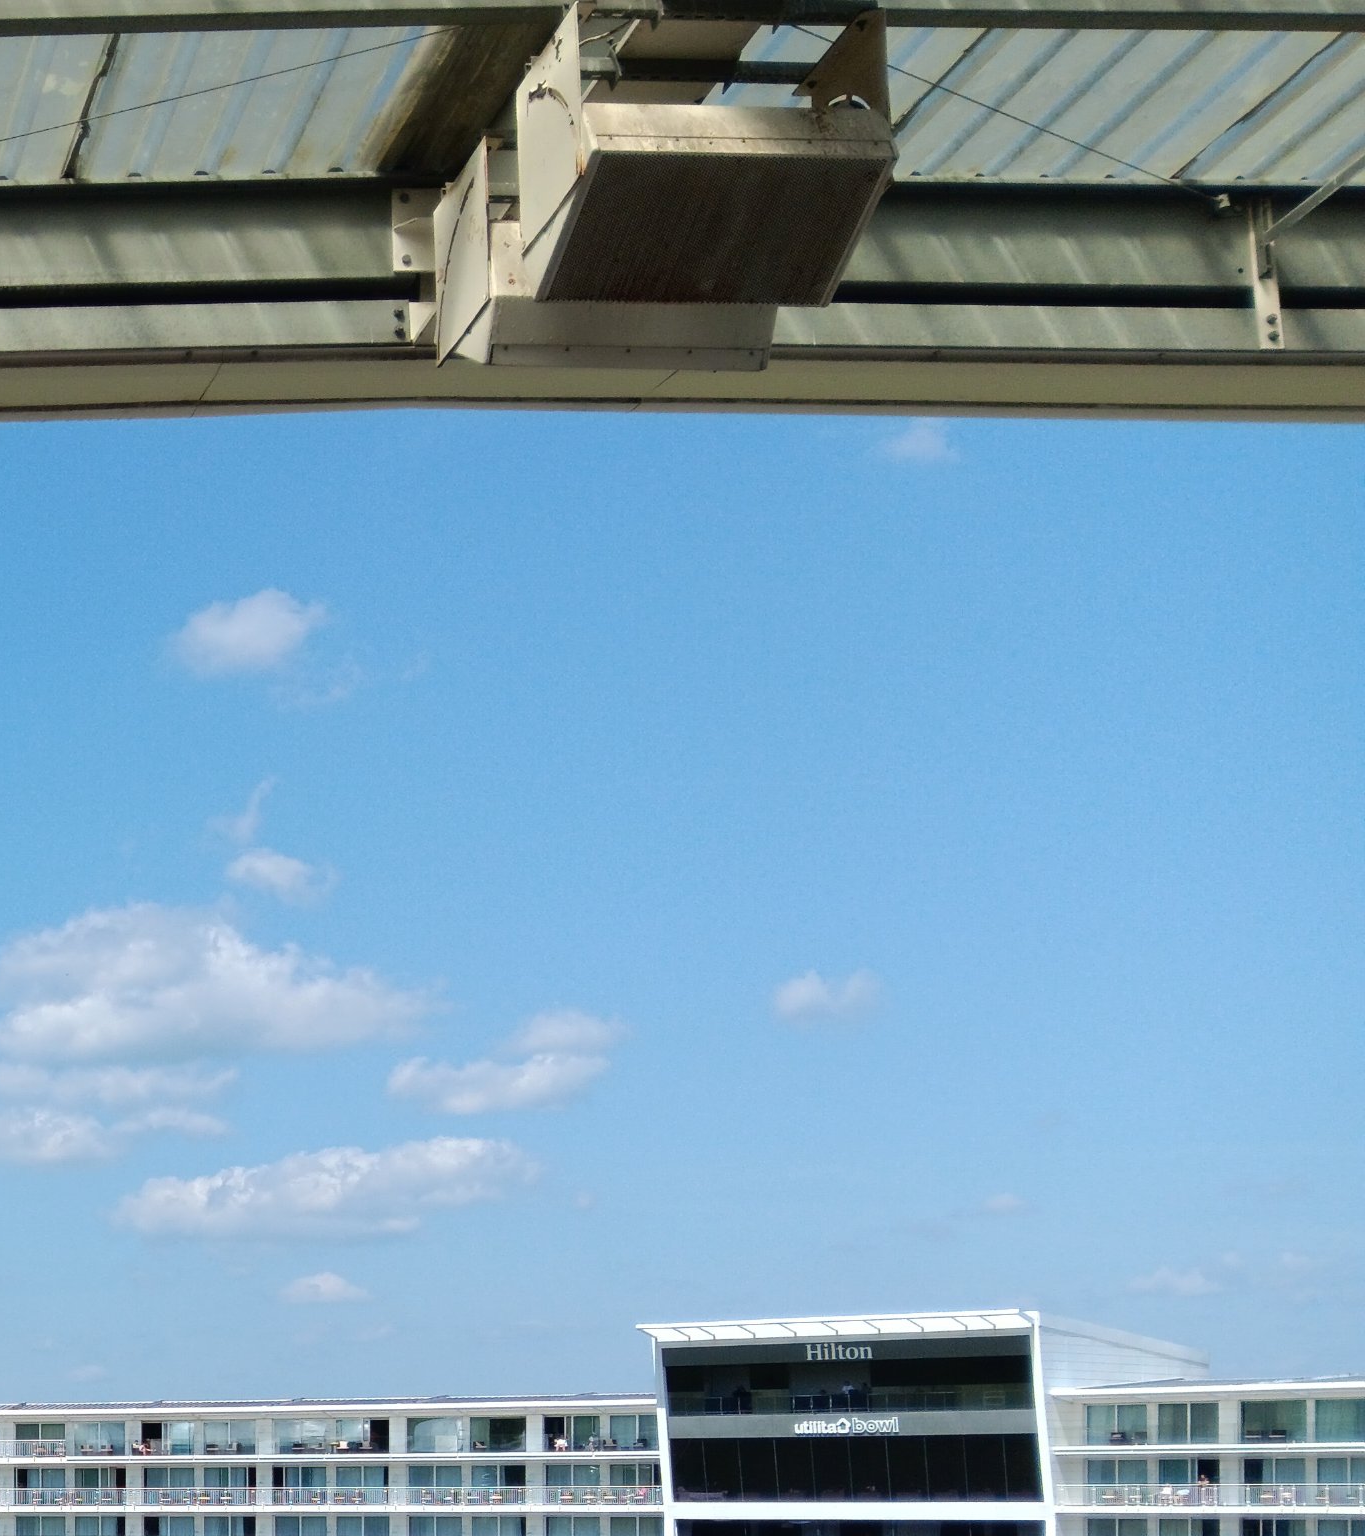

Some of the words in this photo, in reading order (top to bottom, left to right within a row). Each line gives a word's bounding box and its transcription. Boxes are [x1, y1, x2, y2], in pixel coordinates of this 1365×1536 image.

[805, 1343, 873, 1361] Hilton
[794, 1420, 837, 1434] utilita
[852, 1417, 900, 1433] bowl
